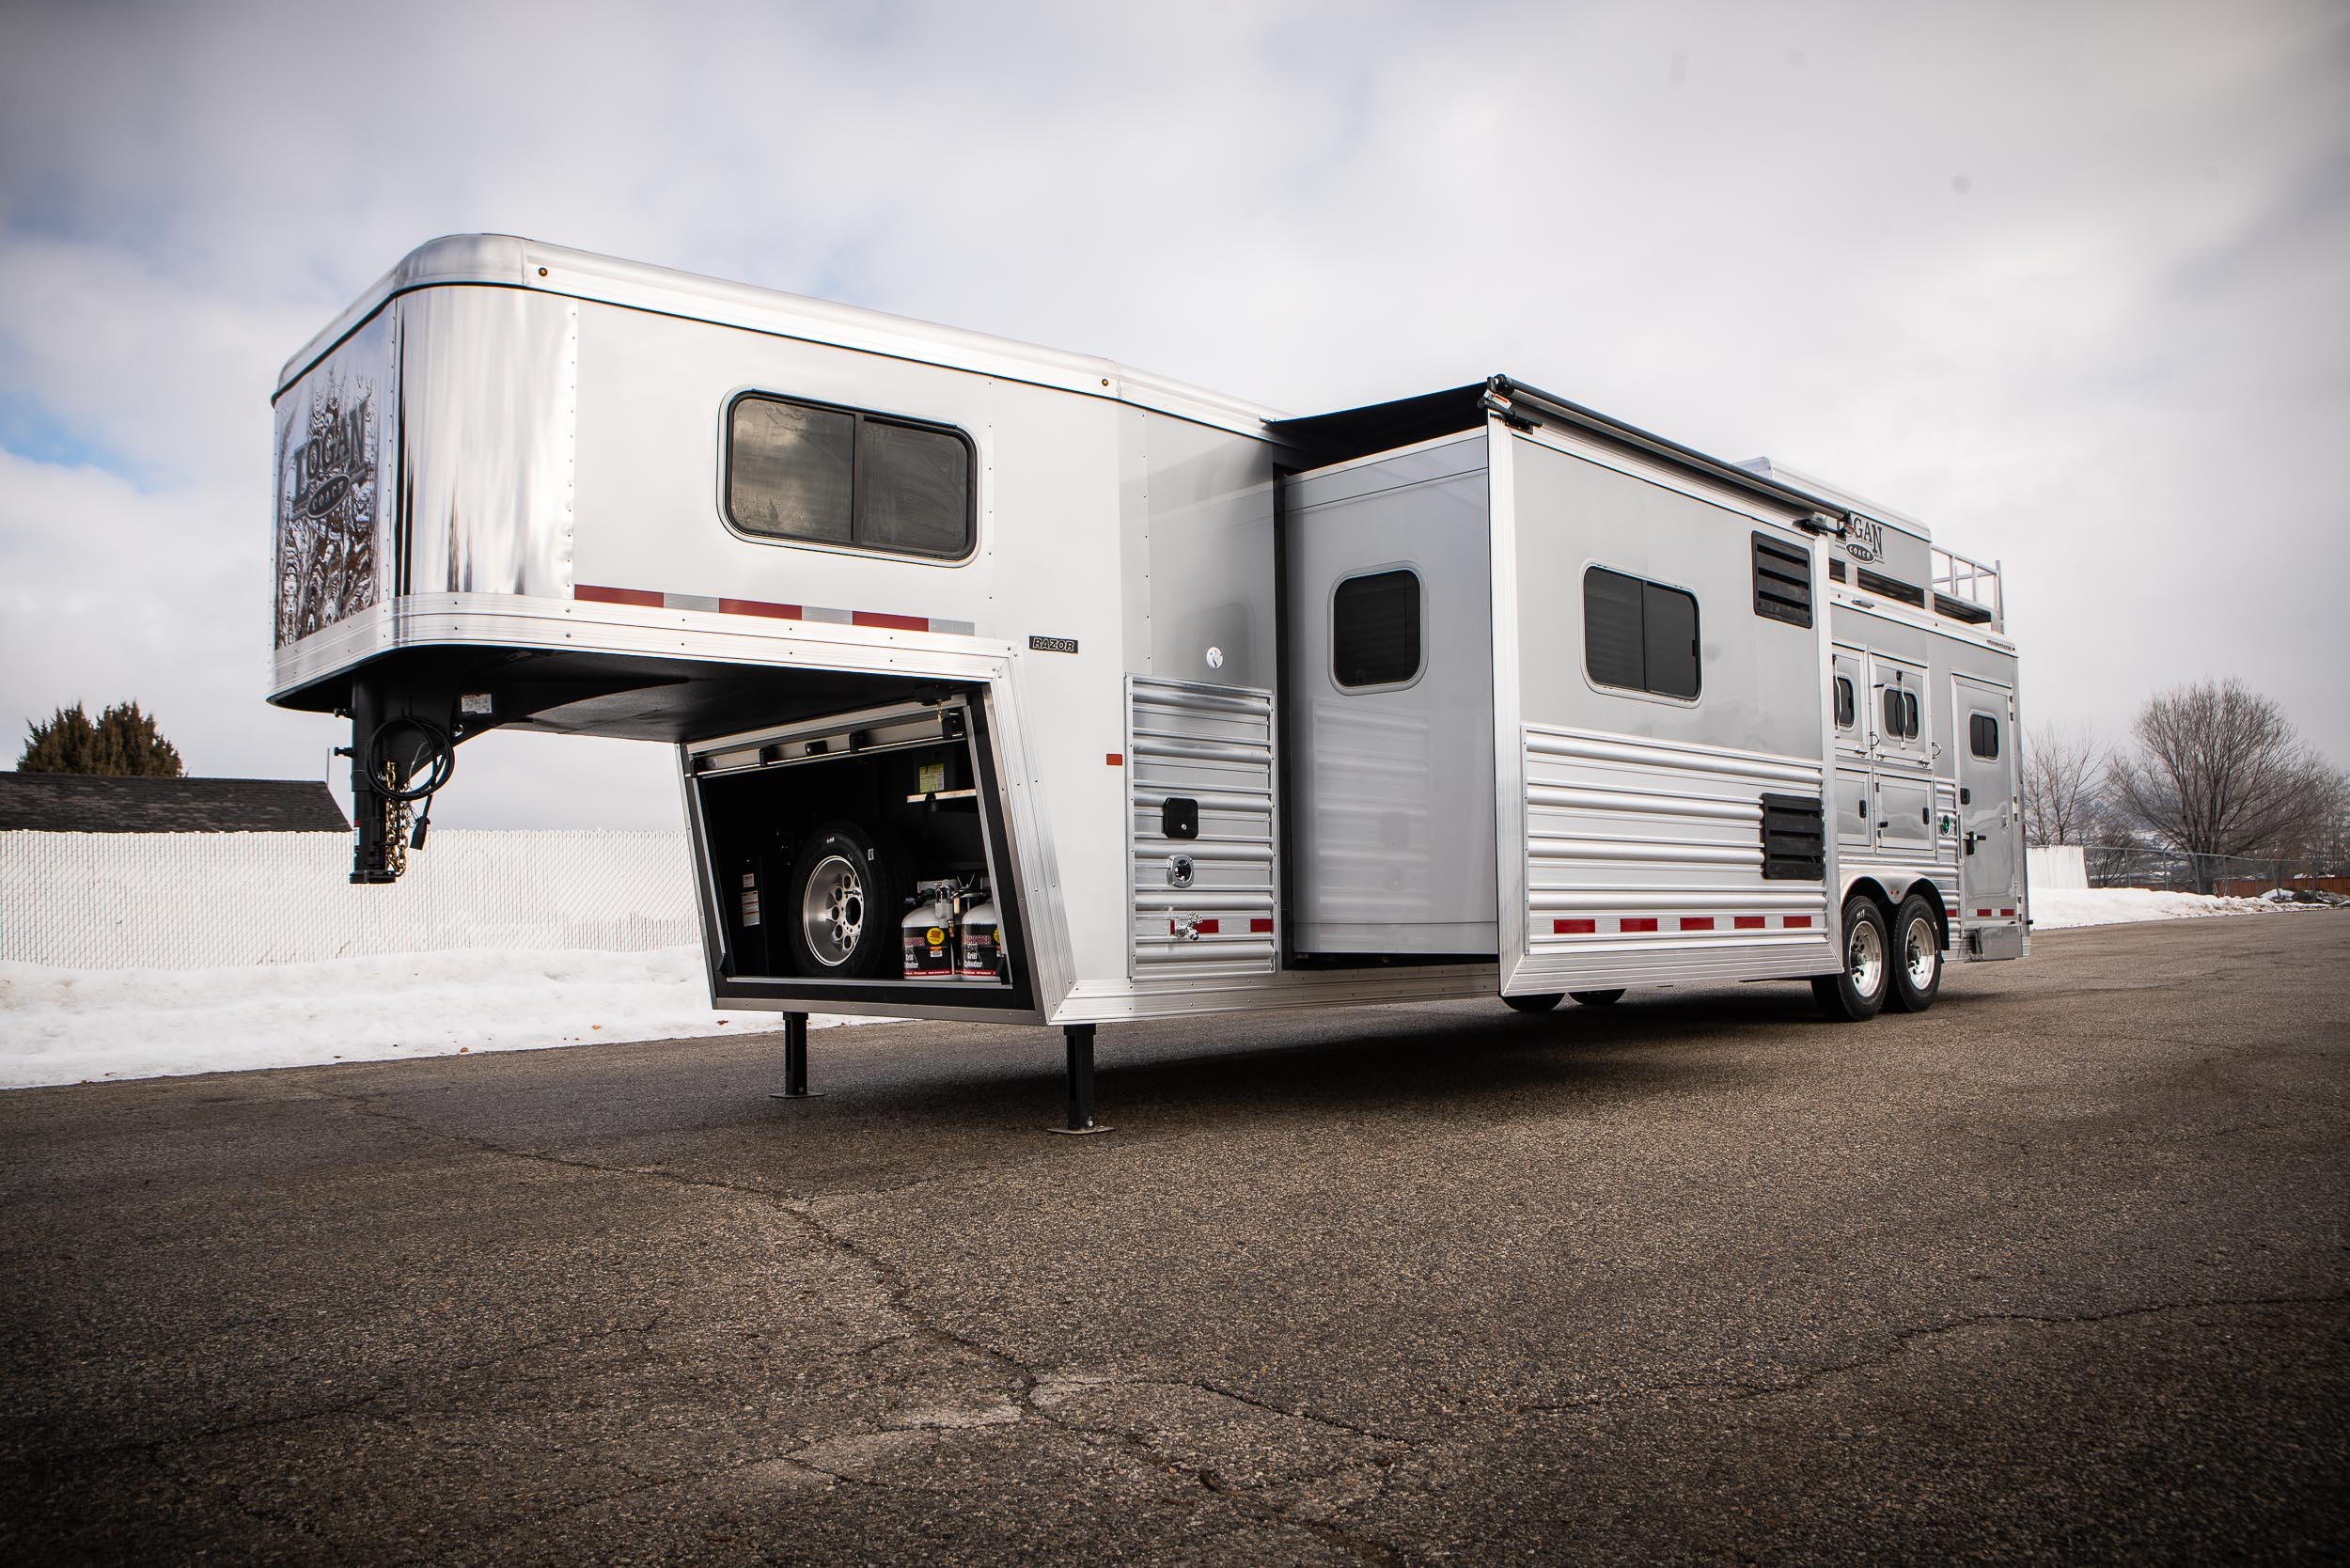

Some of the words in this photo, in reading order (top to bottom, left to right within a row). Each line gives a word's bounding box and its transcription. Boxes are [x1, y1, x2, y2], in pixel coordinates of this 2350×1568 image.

[293, 401, 368, 505] LOGAN
[312, 480, 344, 510] COACH
[1849, 545, 1871, 559] COACH
[1033, 637, 1074, 651] RAZOR
[967, 951, 978, 960] Grill
